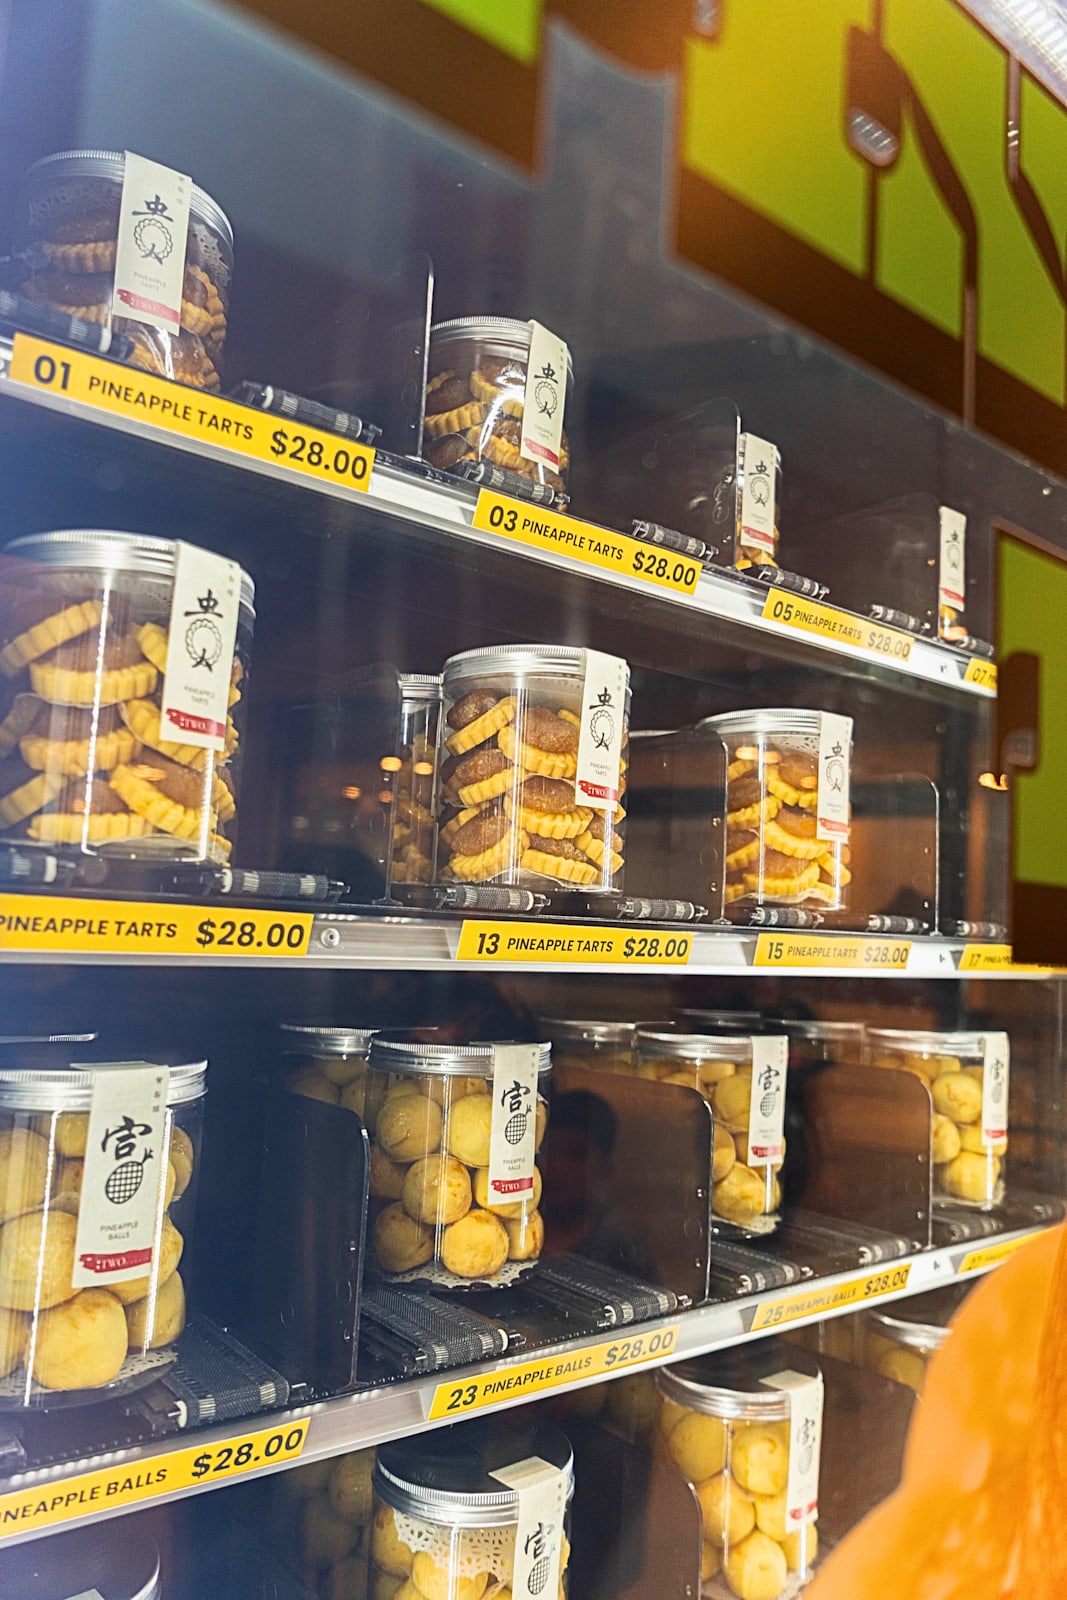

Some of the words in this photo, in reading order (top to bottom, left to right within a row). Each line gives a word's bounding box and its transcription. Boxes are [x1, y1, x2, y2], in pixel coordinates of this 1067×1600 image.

[34, 355, 70, 390] 01
[88, 375, 190, 421] PINEAPPLE
[198, 409, 253, 440] TARTS
[269, 428, 367, 480] $28.00
[489, 505, 518, 532] 03
[521, 518, 585, 548] PINEAPPLE
[588, 539, 624, 561] TARTS
[631, 549, 696, 586] $28.00
[772, 600, 794, 622] 05
[794, 609, 838, 633] PINEAPPLE
[838, 623, 862, 640] TARTS
[867, 630, 911, 658] $28.00
[972, 667, 988, 683] 07
[0, 914, 108, 936] PINEAPPLE
[114, 920, 178, 938] TARTS
[196, 918, 305, 948] $28.00
[477, 933, 501, 955] 13
[507, 937, 574, 953] PINEAPPLE
[576, 940, 614, 953] TARTS
[623, 936, 688, 959] $28.00
[767, 941, 783, 960] 15
[787, 945, 832, 959] PINEAPPLE
[832, 947, 858, 960] TARTS
[864, 946, 909, 965] $28.00
[969, 953, 982, 968] 17
[503, 1157, 526, 1166] PINEAPPLE
[507, 1163, 521, 1171] BALLS
[100, 1221, 139, 1233] PINEAPPLE
[107, 1231, 131, 1241] BALLS
[762, 1304, 783, 1326] 25
[785, 1292, 833, 1317] PINEAPPLE
[832, 1286, 857, 1304] BALLS
[863, 1268, 909, 1297] $28.00
[446, 1384, 478, 1411] 23
[483, 1367, 553, 1396] PINEAPPLE
[555, 1357, 593, 1377] BALLS
[604, 1330, 674, 1368] $28.00
[0, 1485, 101, 1524] NEAPPLE
[105, 1468, 168, 1496] BALLS
[191, 1428, 303, 1478] $28.00
